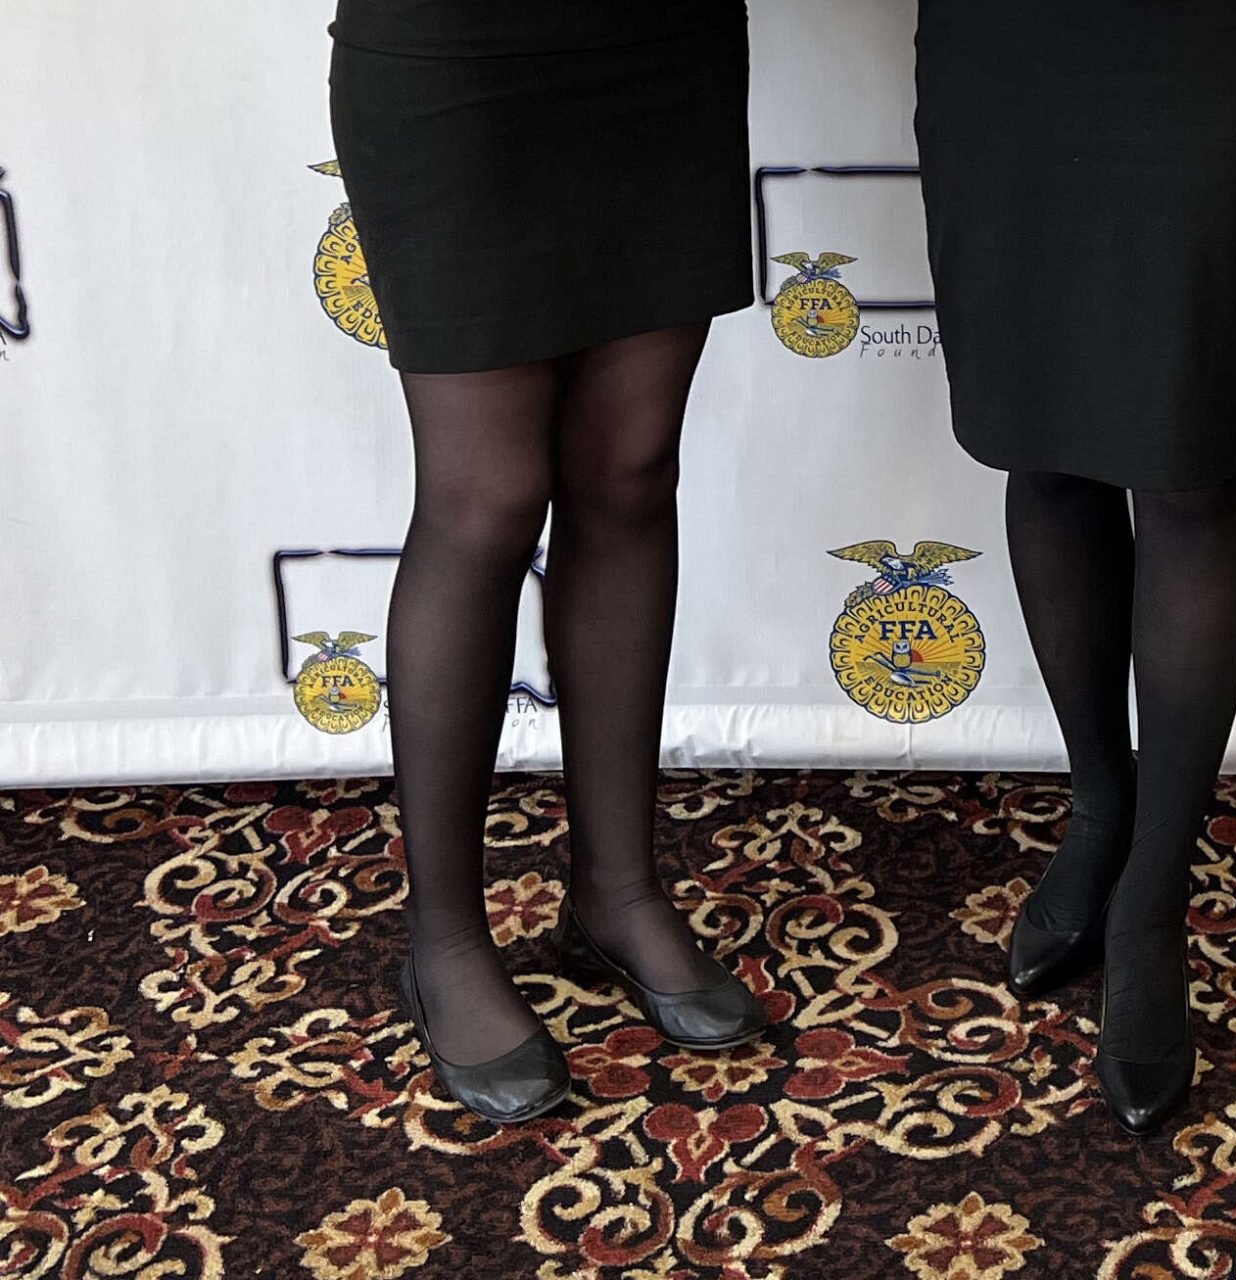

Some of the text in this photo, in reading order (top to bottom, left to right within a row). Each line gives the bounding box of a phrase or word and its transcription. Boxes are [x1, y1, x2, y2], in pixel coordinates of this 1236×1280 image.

[800, 298, 833, 310] FFA
[860, 324, 911, 346] South
[854, 601, 960, 644] AGRICULTURAL
[878, 620, 938, 640] FFA
[321, 675, 355, 688] FFA
[864, 672, 955, 702] EDUCATION
